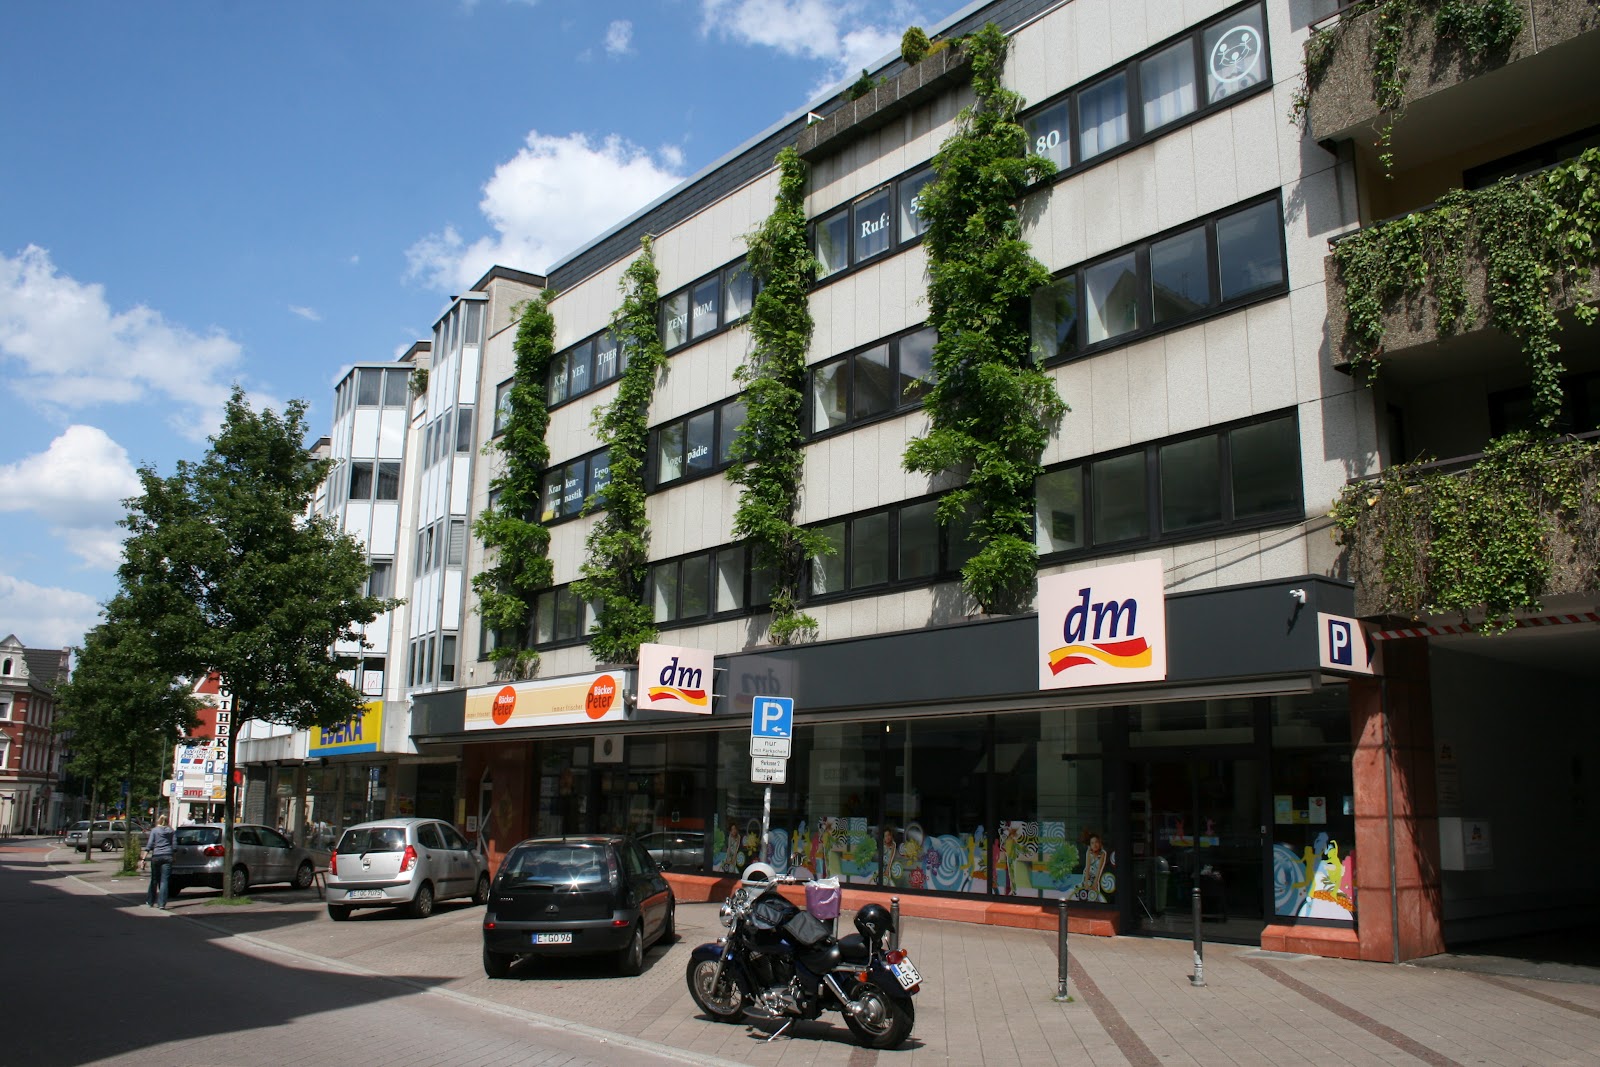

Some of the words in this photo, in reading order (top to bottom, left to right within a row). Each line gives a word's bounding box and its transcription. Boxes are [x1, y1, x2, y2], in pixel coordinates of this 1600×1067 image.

[861, 212, 890, 239] Ruf:
[1035, 129, 1060, 155] 80
[667, 300, 713, 332] ZENTRUM
[669, 445, 708, 467] ogopädie
[1063, 587, 1137, 644] dm
[1331, 623, 1348, 660] P
[659, 656, 703, 689] dm
[498, 695, 515, 704] Bäcker
[587, 692, 612, 709] Peter
[594, 685, 614, 696] Bäcker
[492, 702, 513, 716] Peter
[761, 702, 783, 732] P
[537, 933, 543, 943] E
[548, 933, 559, 943] GO
[559, 933, 571, 943] 96
[900, 973, 914, 987] US
[911, 968, 920, 980] 3
